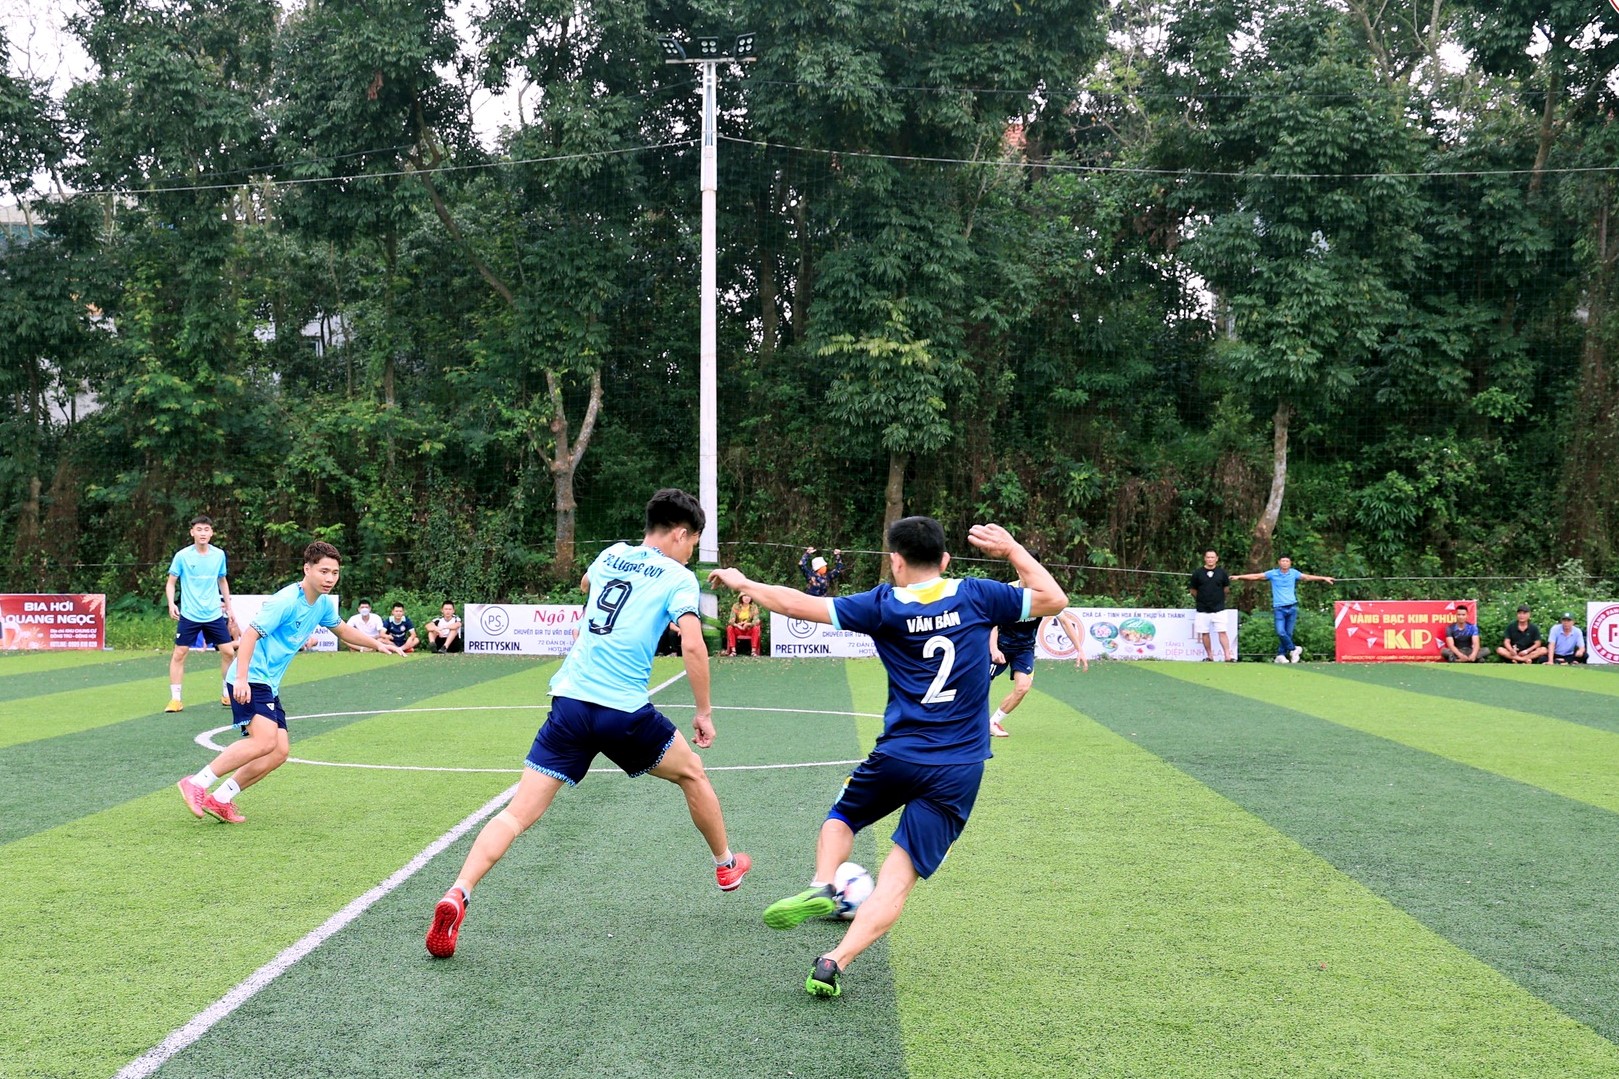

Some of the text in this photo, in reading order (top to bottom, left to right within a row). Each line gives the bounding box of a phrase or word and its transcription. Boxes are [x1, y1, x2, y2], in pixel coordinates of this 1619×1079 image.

[24, 600, 73, 611] BIA HƠI
[588, 578, 633, 635] 9
[5, 614, 96, 626] QUANG NGỌC
[533, 609, 586, 626] Ngô M
[906, 615, 933, 633] VĂN
[1350, 612, 1379, 624] VÀNG
[1383, 614, 1404, 626] BẠC
[1408, 614, 1428, 624] KIM
[1384, 629, 1432, 649] KP
[920, 635, 957, 704] 2
